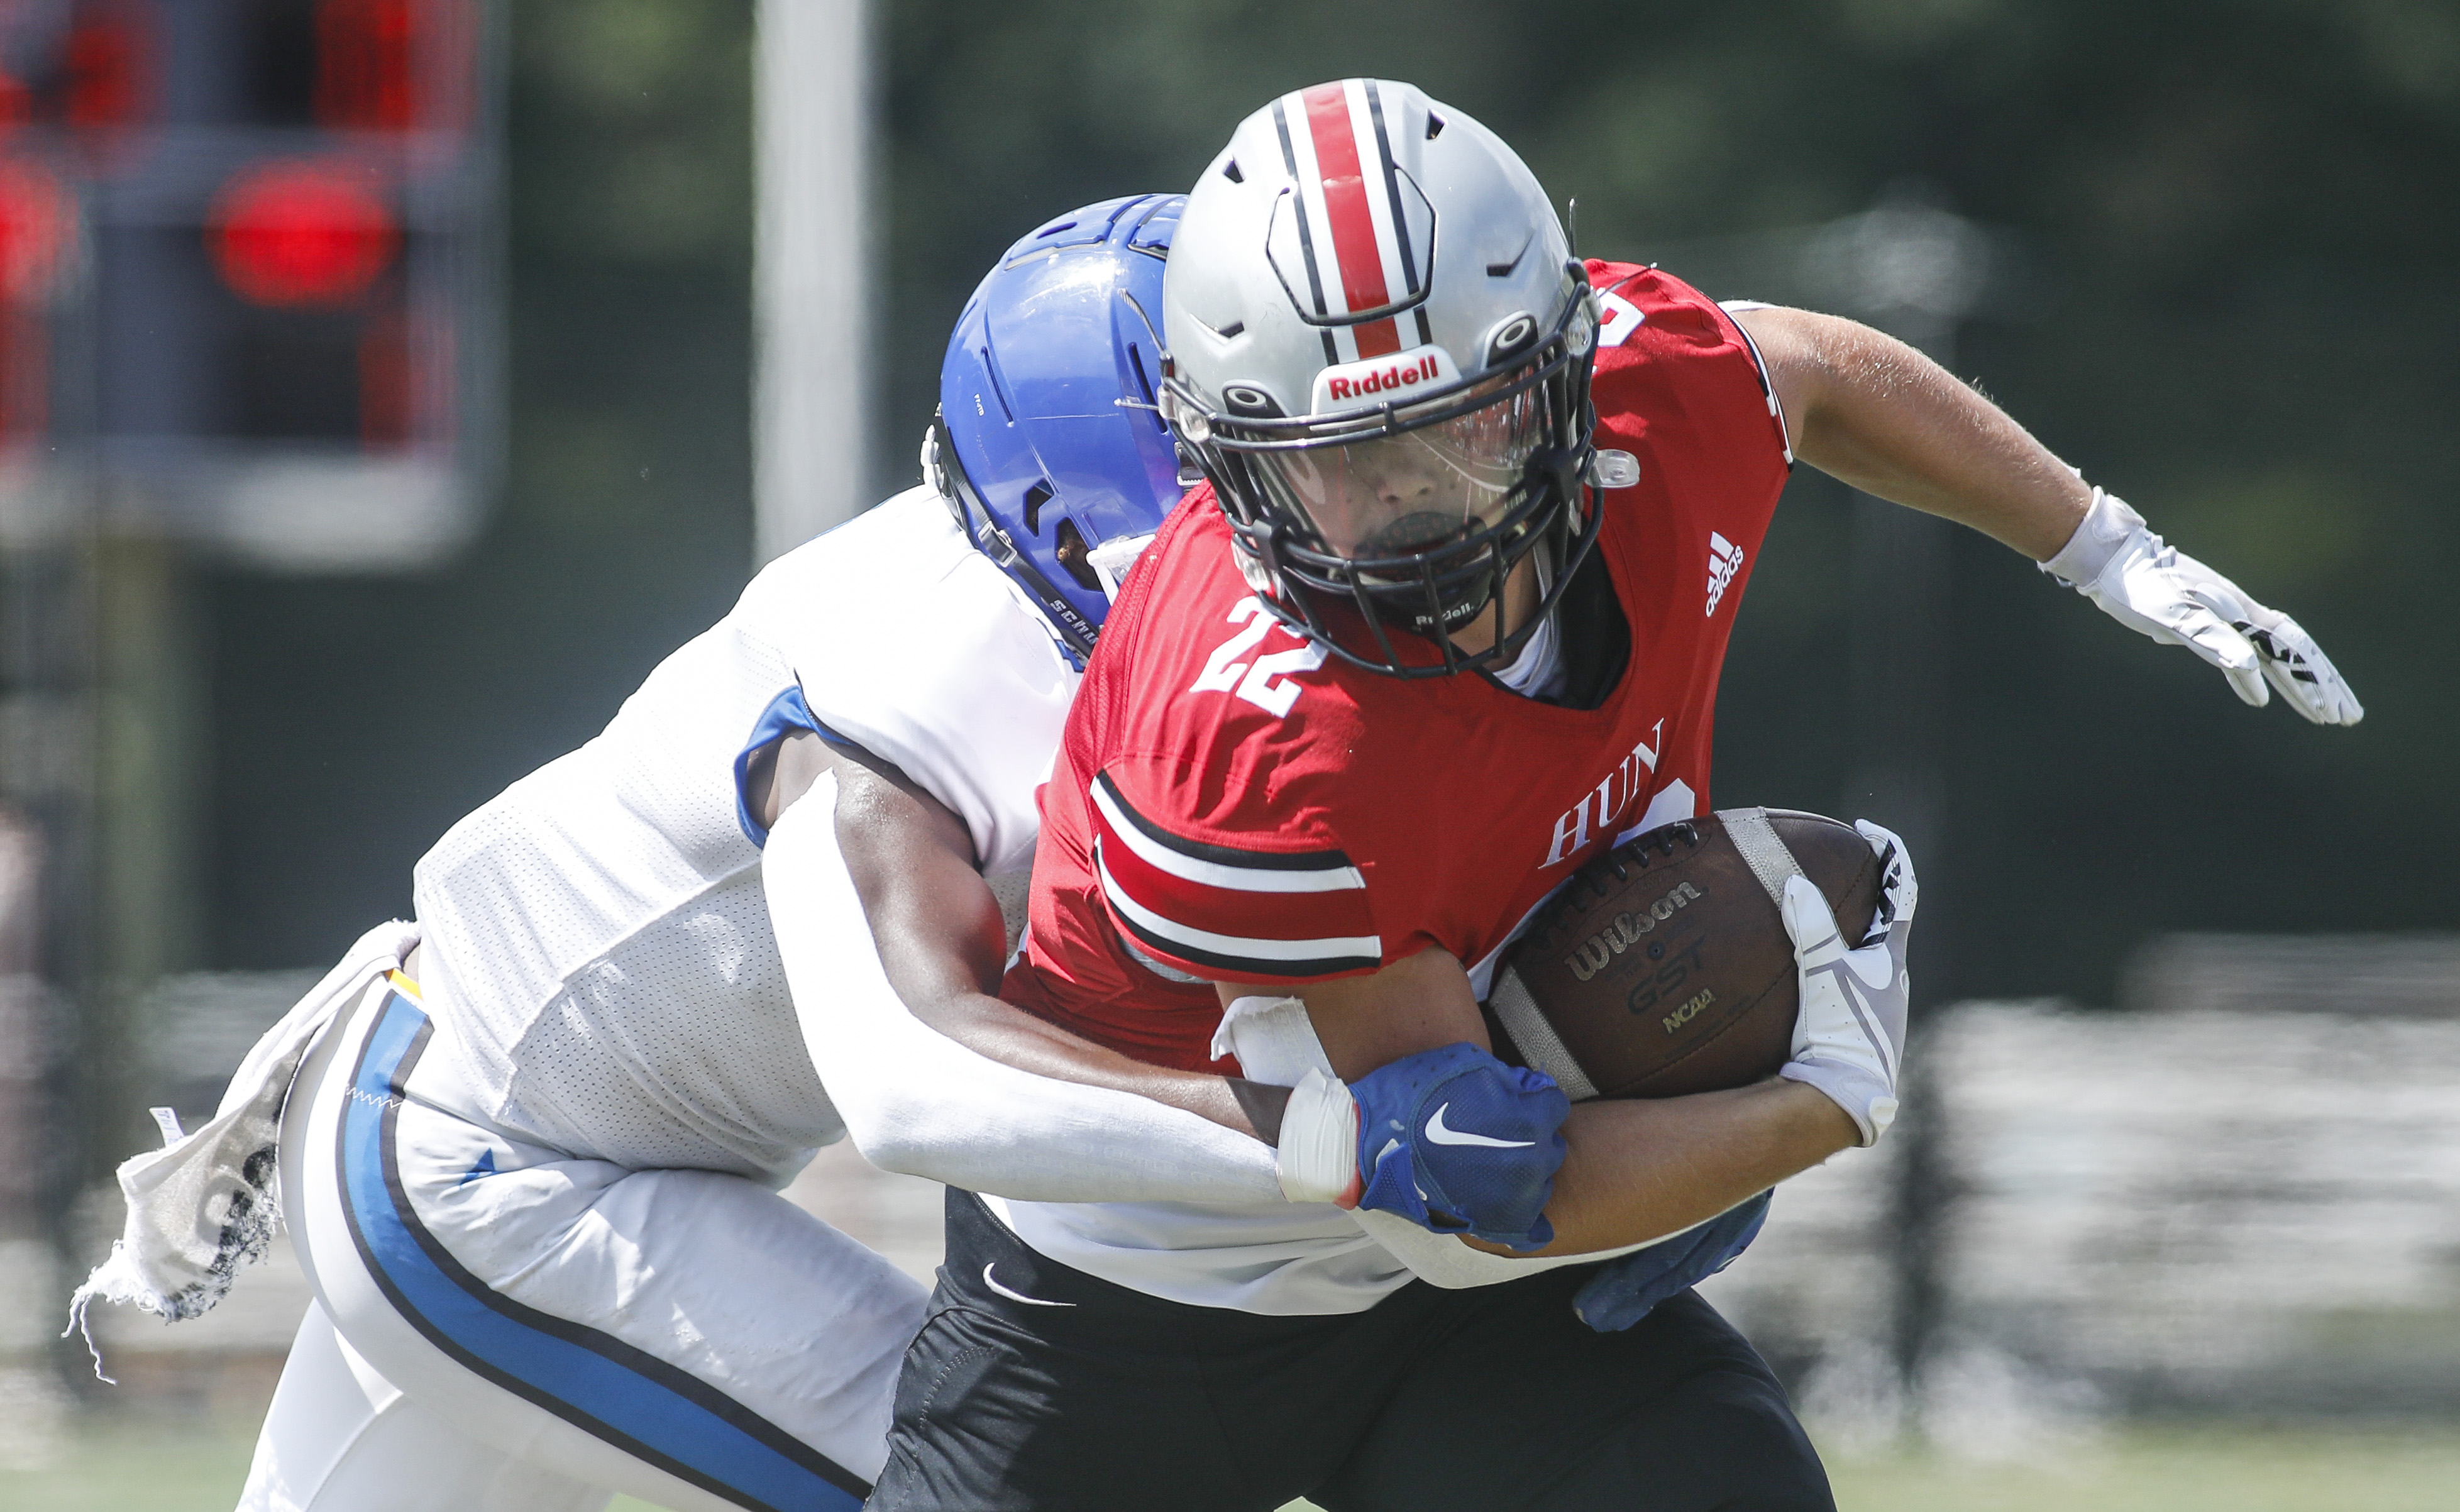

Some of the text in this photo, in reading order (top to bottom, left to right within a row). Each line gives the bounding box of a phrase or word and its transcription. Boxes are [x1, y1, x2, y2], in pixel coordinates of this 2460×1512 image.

[1328, 355, 1438, 400] Riddell
[1416, 603, 1470, 626] Ridell
[1706, 545, 1744, 617] adidas
[1189, 595, 1328, 719] 22
[1538, 717, 1664, 869] HUN
[1564, 882, 1701, 981] Wilson
[1628, 934, 1706, 1015] GST
[1662, 988, 1716, 1034] NCAA
